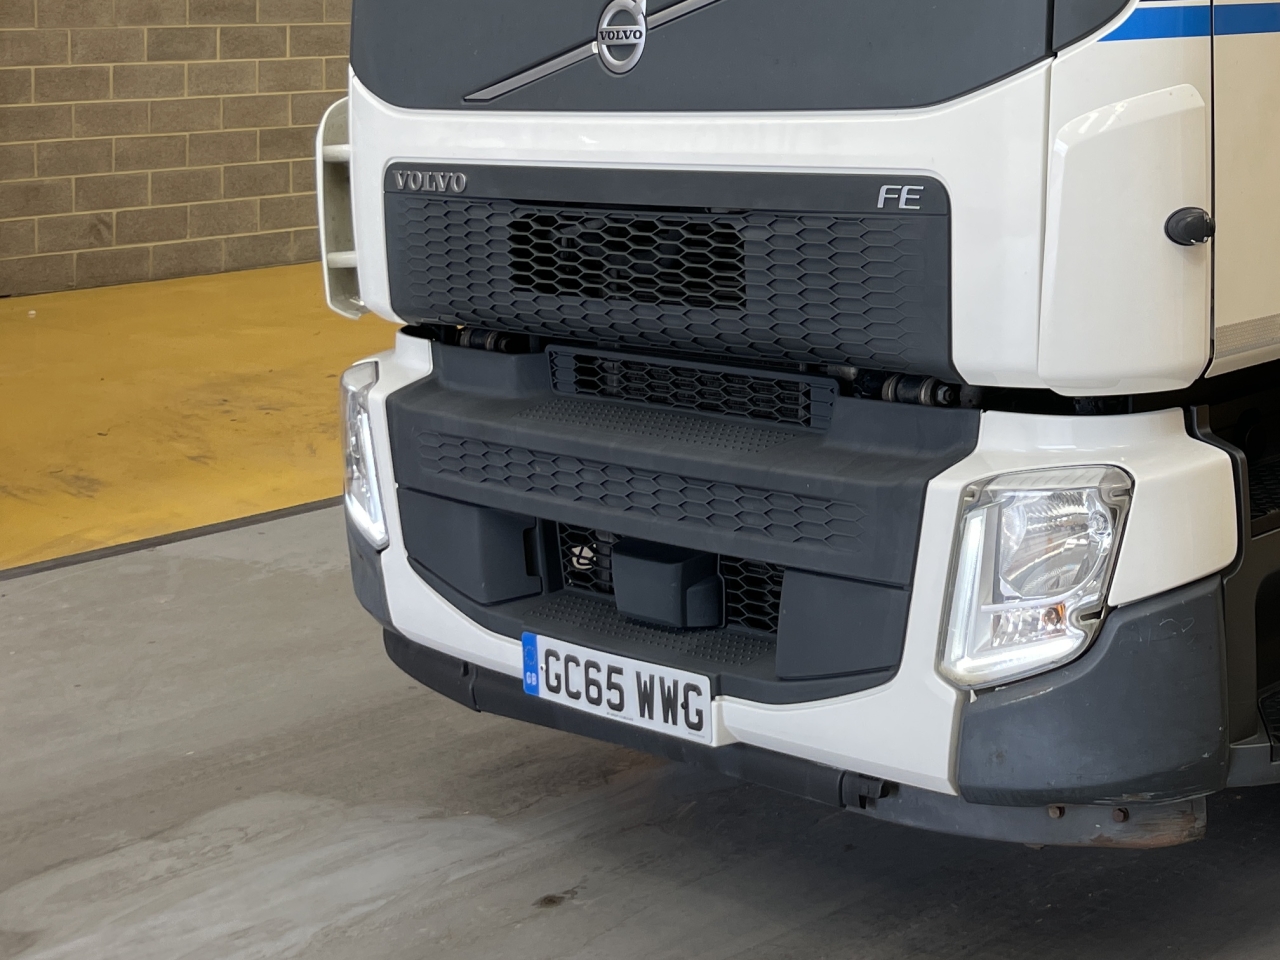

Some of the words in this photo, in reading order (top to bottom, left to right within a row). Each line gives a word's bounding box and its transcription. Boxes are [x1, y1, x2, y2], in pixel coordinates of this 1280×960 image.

[599, 29, 643, 41] VOLVO
[392, 170, 466, 193] VOLVO
[877, 184, 924, 210] FE
[526, 671, 537, 686] GB
[544, 648, 625, 712] GC65
[635, 670, 704, 732] WWG
